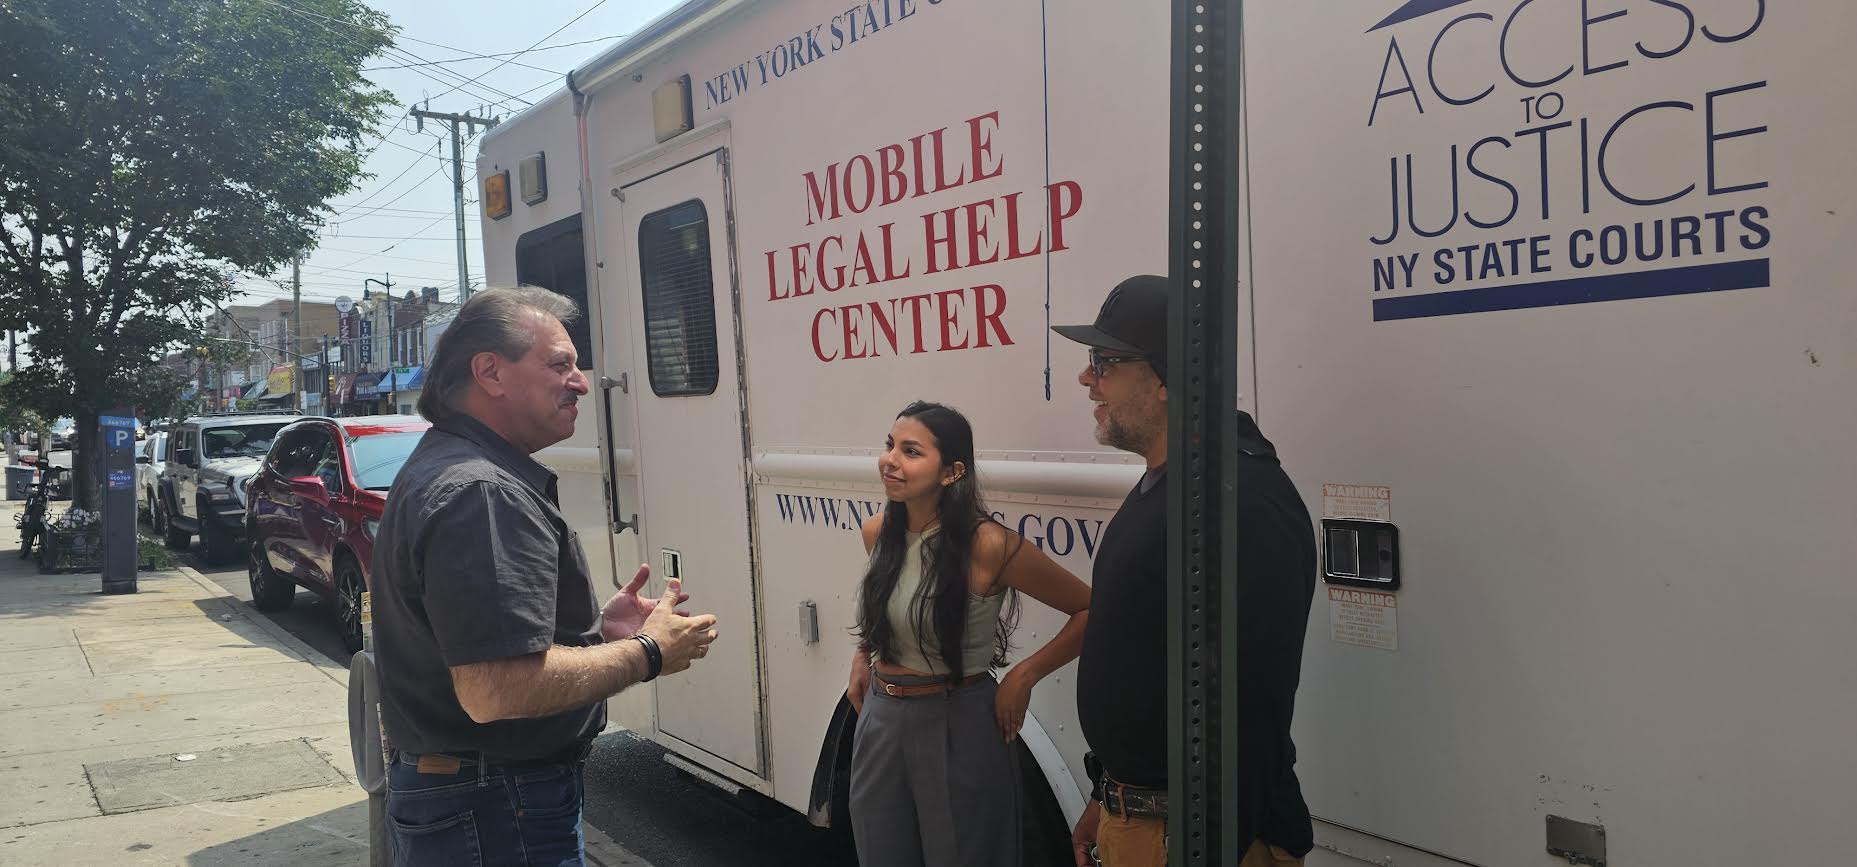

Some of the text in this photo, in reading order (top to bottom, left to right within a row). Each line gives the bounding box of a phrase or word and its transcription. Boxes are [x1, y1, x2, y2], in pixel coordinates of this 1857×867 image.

[704, 60, 751, 111] NEW
[756, 24, 826, 86] YORK
[1520, 91, 1564, 124] TO
[802, 110, 1004, 226] MOBILE
[1369, 80, 1769, 246] JUSTICE
[764, 180, 1083, 302] LEGAL HELP
[1373, 205, 1771, 292] NY STATE COURTS
[340, 313, 351, 345] PIZZA
[811, 283, 1015, 363] CENTER
[115, 430, 128, 446] P
[1330, 588, 1395, 607] WARNING
